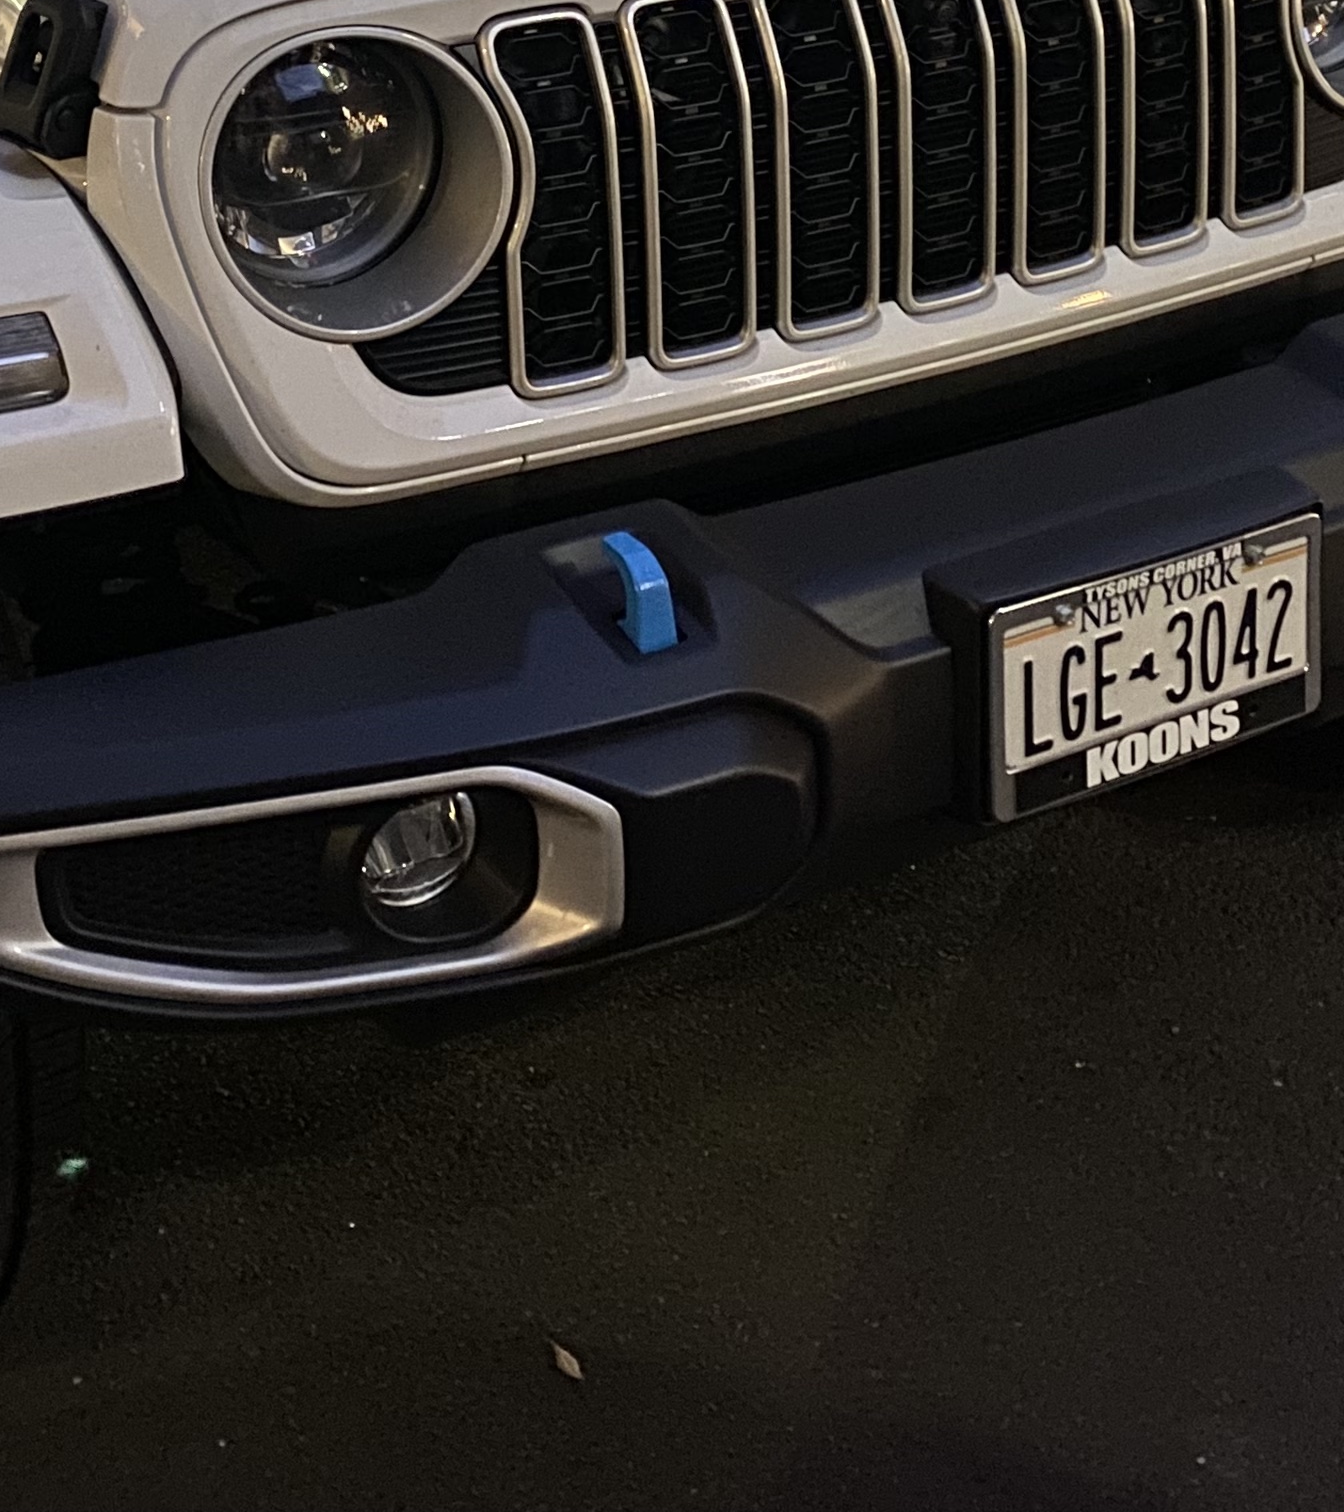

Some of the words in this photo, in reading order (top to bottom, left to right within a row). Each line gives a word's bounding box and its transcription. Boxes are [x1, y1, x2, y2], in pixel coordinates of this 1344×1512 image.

[1079, 587, 1151, 634] NEW
[1161, 561, 1240, 608] YORK
[1083, 570, 1150, 604] TYSONS
[1222, 541, 1243, 562] VA
[1023, 630, 1123, 758] LGE
[1166, 579, 1294, 704] 3042
[1086, 699, 1241, 789] KOONS
